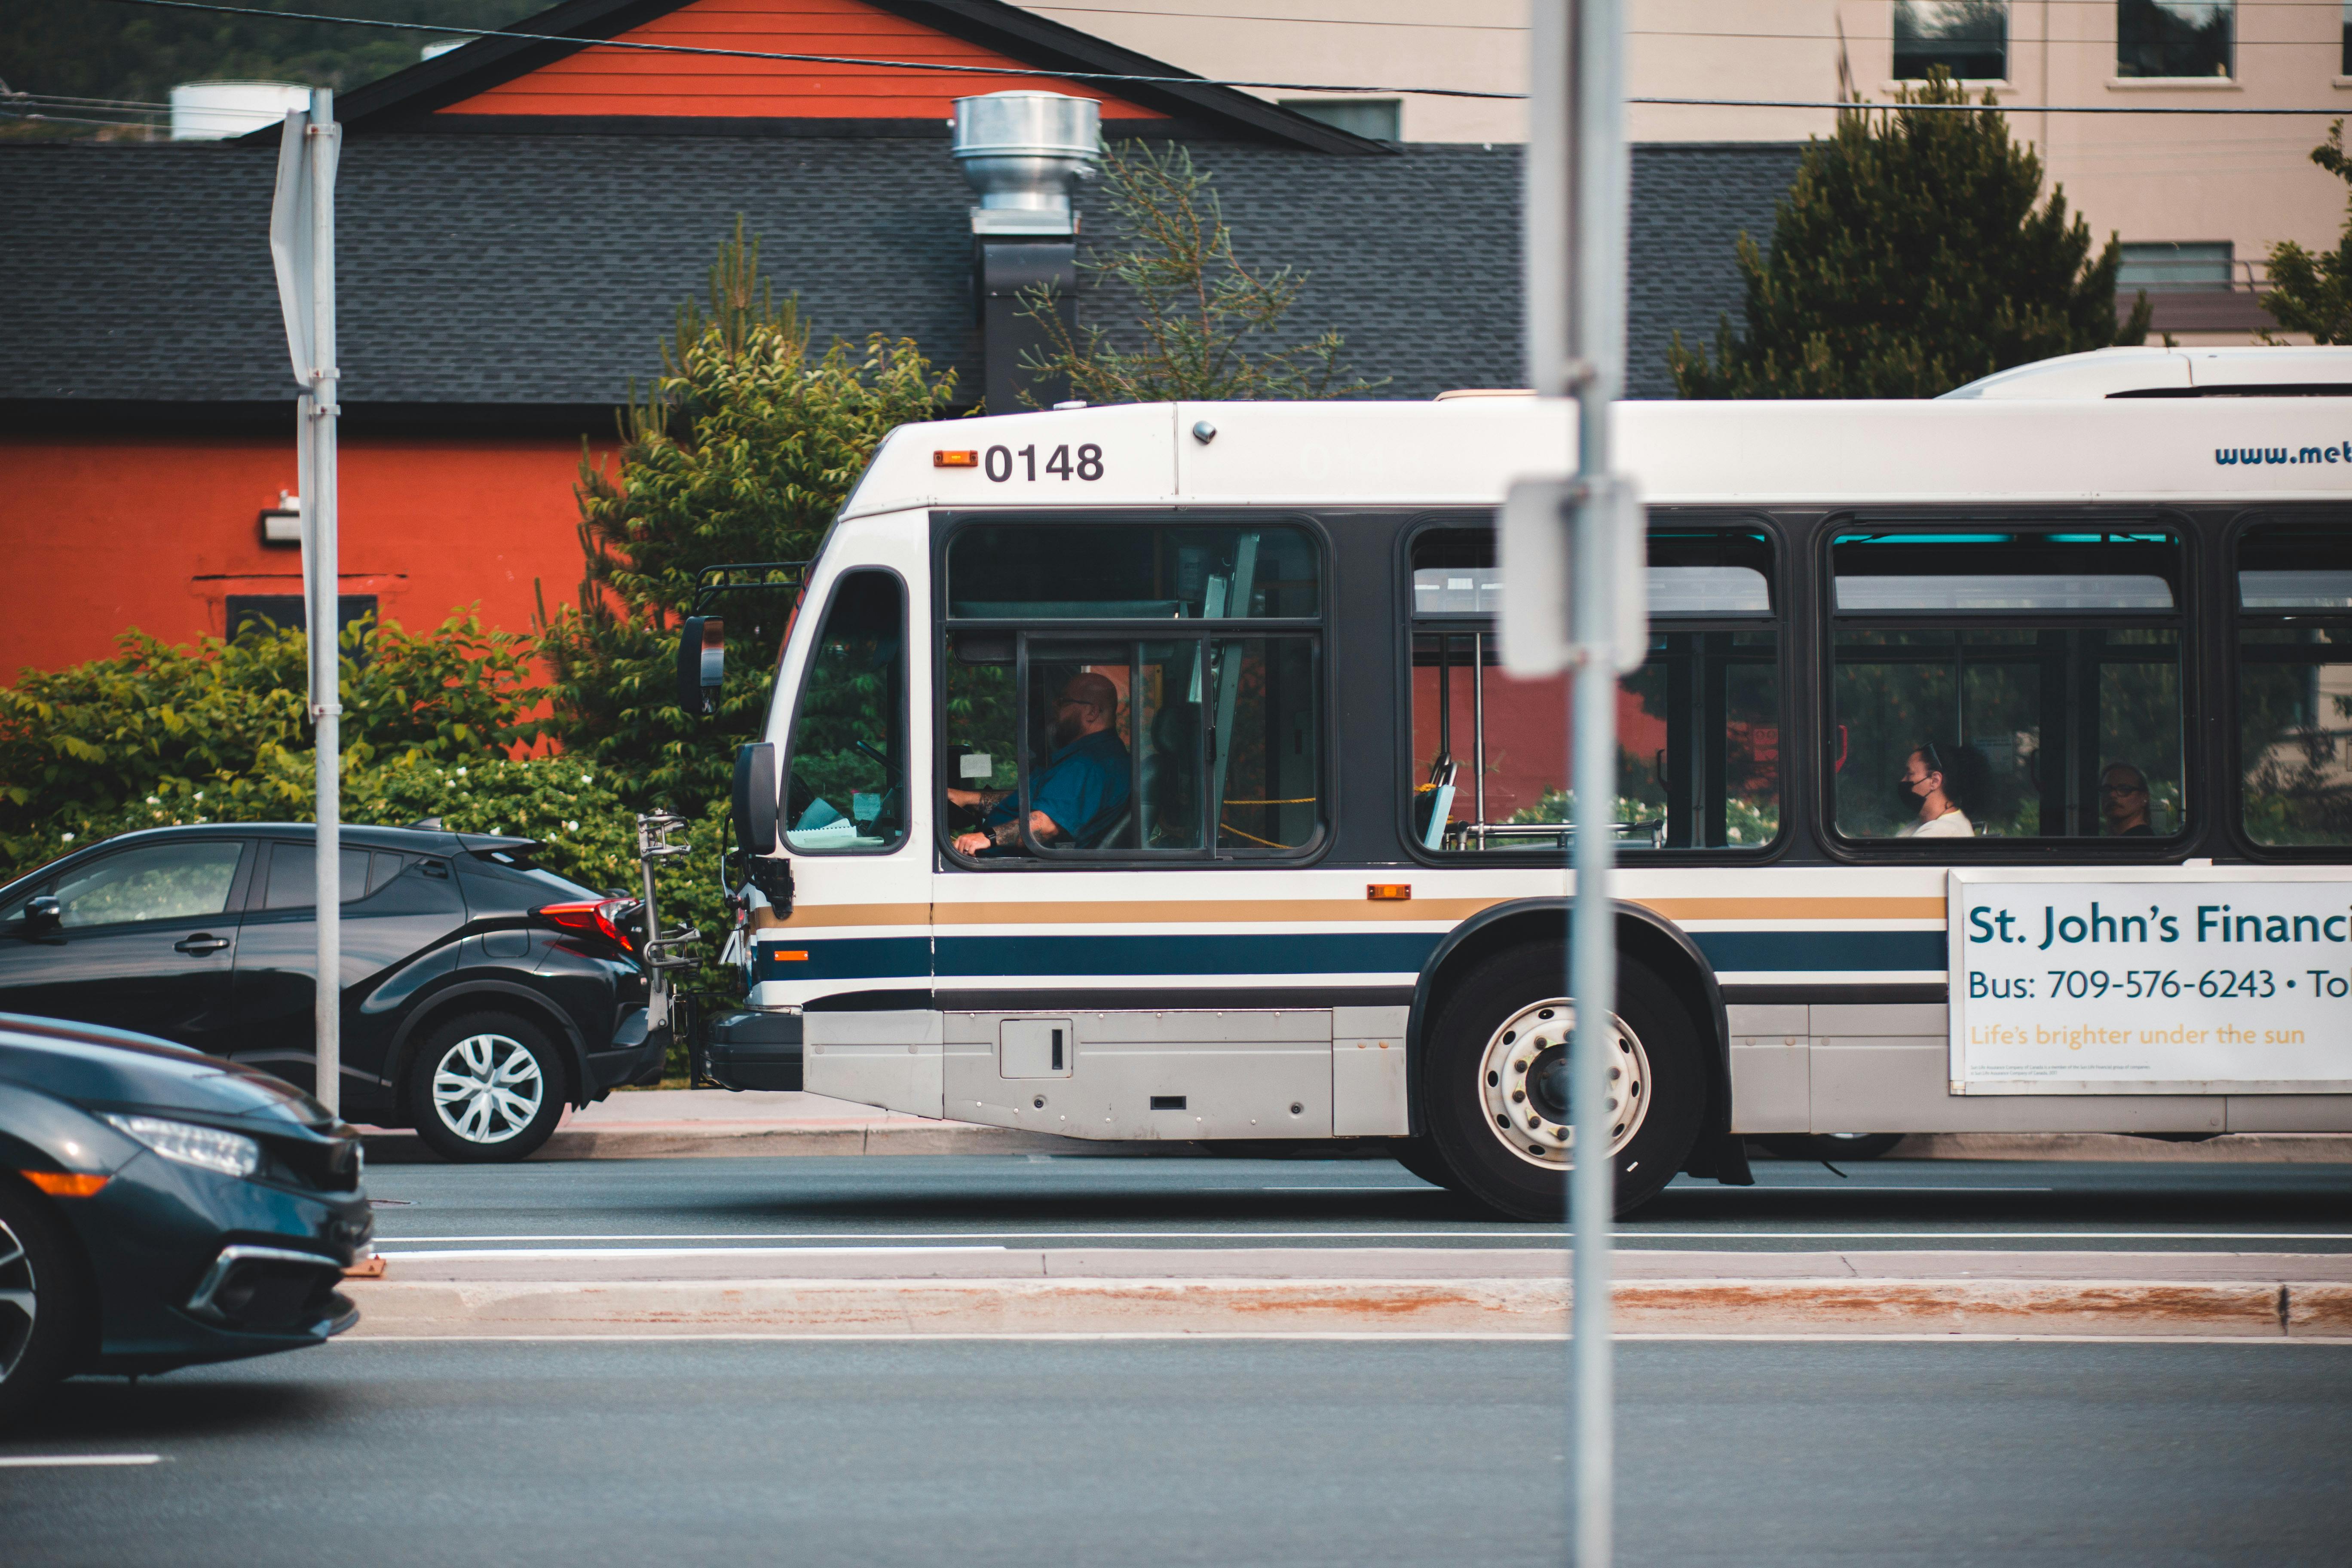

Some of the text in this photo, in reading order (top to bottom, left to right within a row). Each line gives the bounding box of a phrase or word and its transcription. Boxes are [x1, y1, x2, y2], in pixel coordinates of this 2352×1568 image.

[985, 443, 1104, 482] 0148
[2215, 441, 2352, 465] www.met
[1969, 902, 2352, 951] St. John’s Financi
[1969, 967, 2352, 999] Bus: 709-576-6243 To
[1971, 1024, 2306, 1050] Life’s brighter under the sun
